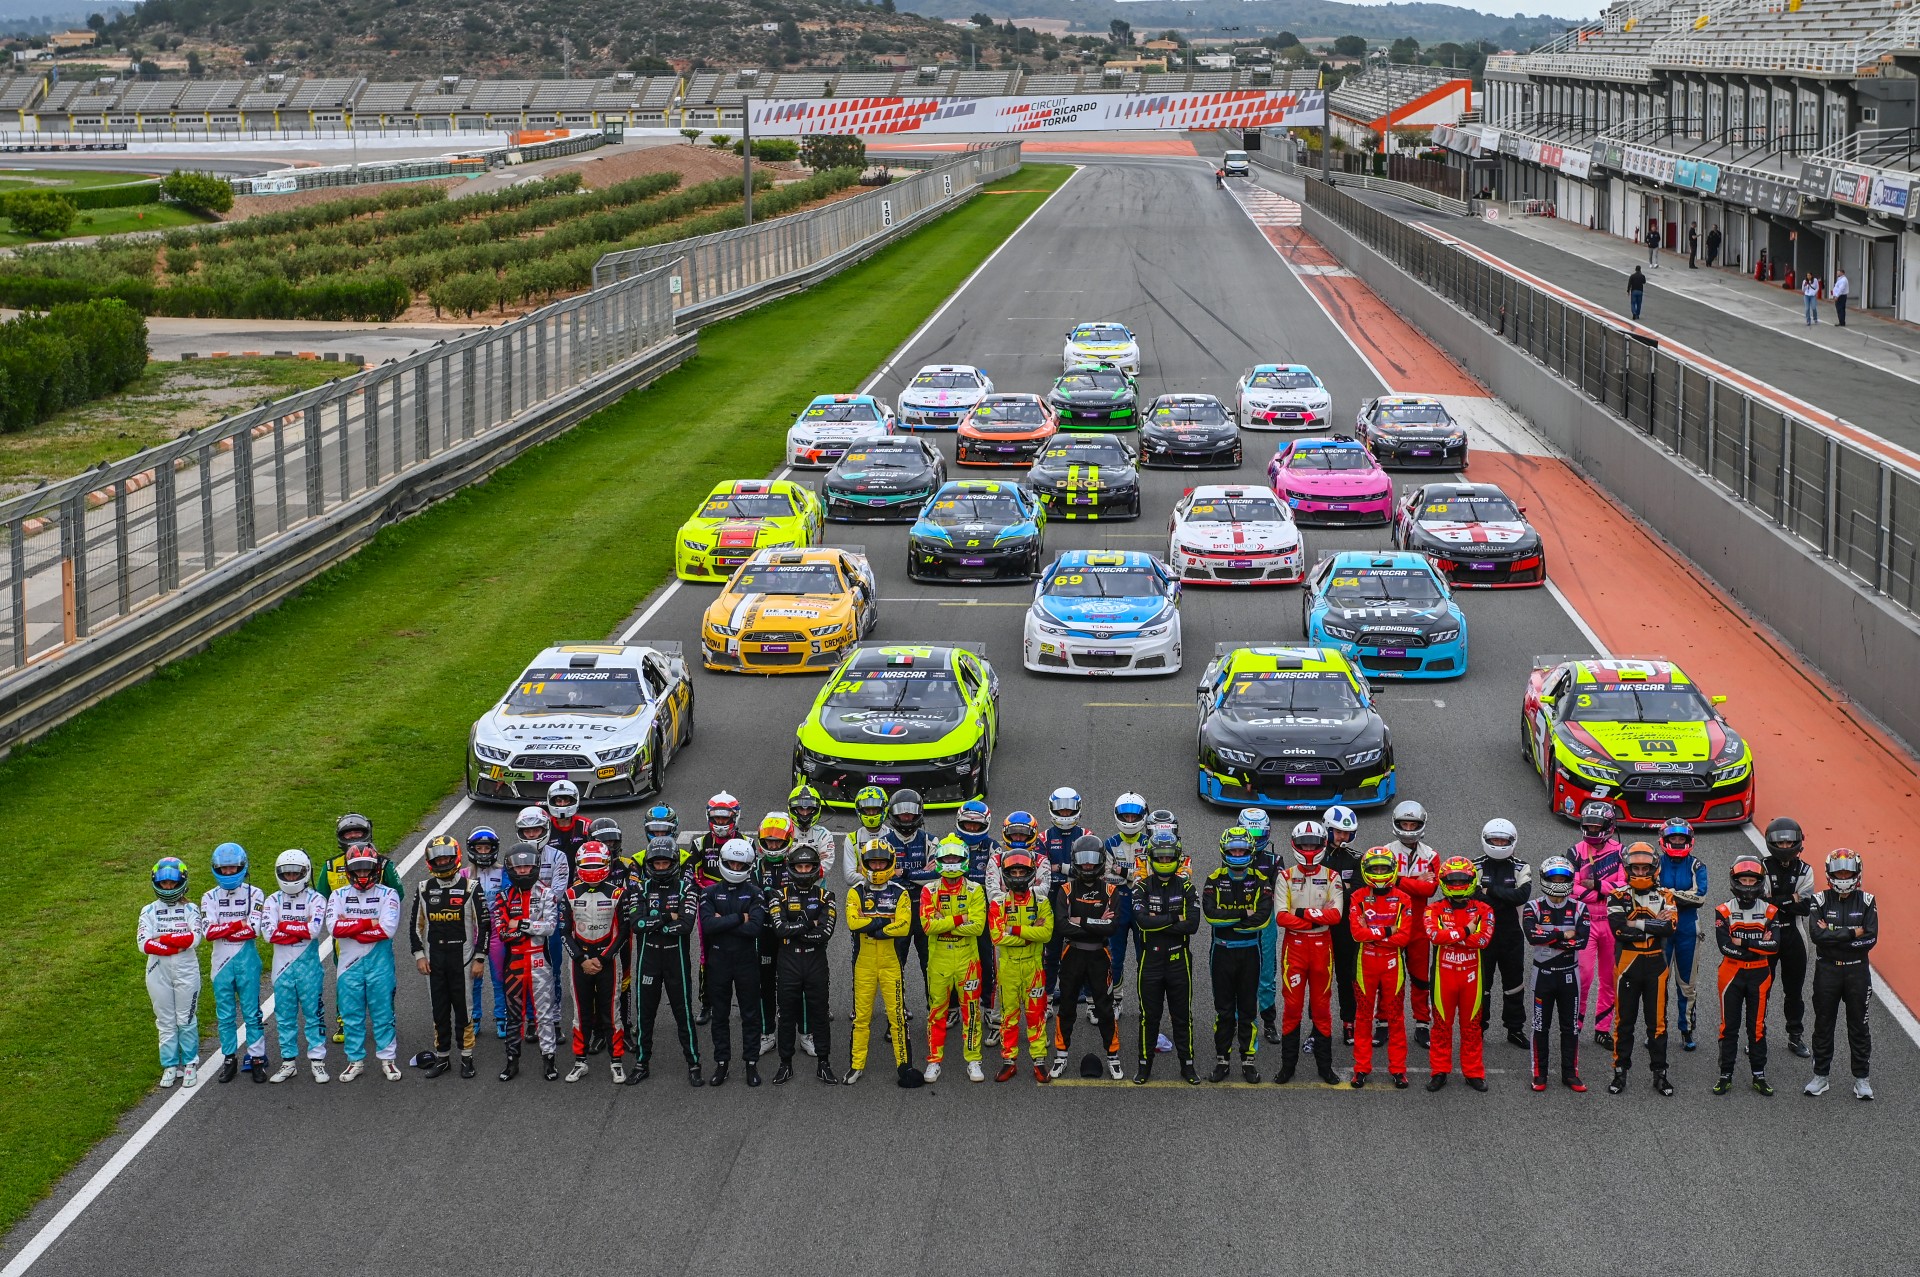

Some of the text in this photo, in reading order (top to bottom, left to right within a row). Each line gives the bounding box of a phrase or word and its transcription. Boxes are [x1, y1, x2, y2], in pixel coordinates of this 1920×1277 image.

[1031, 98, 1068, 110] CIRCUIT
[1053, 102, 1097, 116] RICARDO
[1042, 114, 1077, 127] TORMO
[883, 201, 891, 225] 150
[976, 407, 991, 415] 13
[1056, 480, 1107, 488] DINOIL
[706, 502, 729, 510] 30
[935, 501, 954, 509] 34
[1192, 505, 1214, 513] 99
[1426, 505, 1448, 513] 48
[1429, 558, 1439, 567] 48
[741, 576, 755, 585] 5
[1054, 575, 1083, 586] 69
[1332, 578, 1359, 587] 64
[1362, 625, 1420, 633] SPEEDHOUSE
[811, 641, 821, 653] 5
[519, 682, 546, 695] 11
[834, 681, 864, 693] 24
[1235, 682, 1252, 694] 7
[1619, 683, 1665, 691] NASCAR
[1577, 694, 1592, 707] 3
[1247, 715, 1343, 725] orion
[503, 724, 618, 732] ALUMITEC
[1282, 747, 1316, 755] orion
[598, 768, 616, 776] HPM
[1227, 767, 1236, 775] 7
[1590, 785, 1611, 798] 3
[429, 912, 461, 922] DINOIL
[148, 940, 168, 950] MOTUL
[1170, 953, 1181, 961] 24
[533, 959, 545, 967] 99
[1387, 958, 1397, 969] 3
[1290, 974, 1301, 988] 3
[1467, 970, 1476, 983] 3
[964, 978, 980, 990] 30
[1030, 987, 1044, 998] 30
